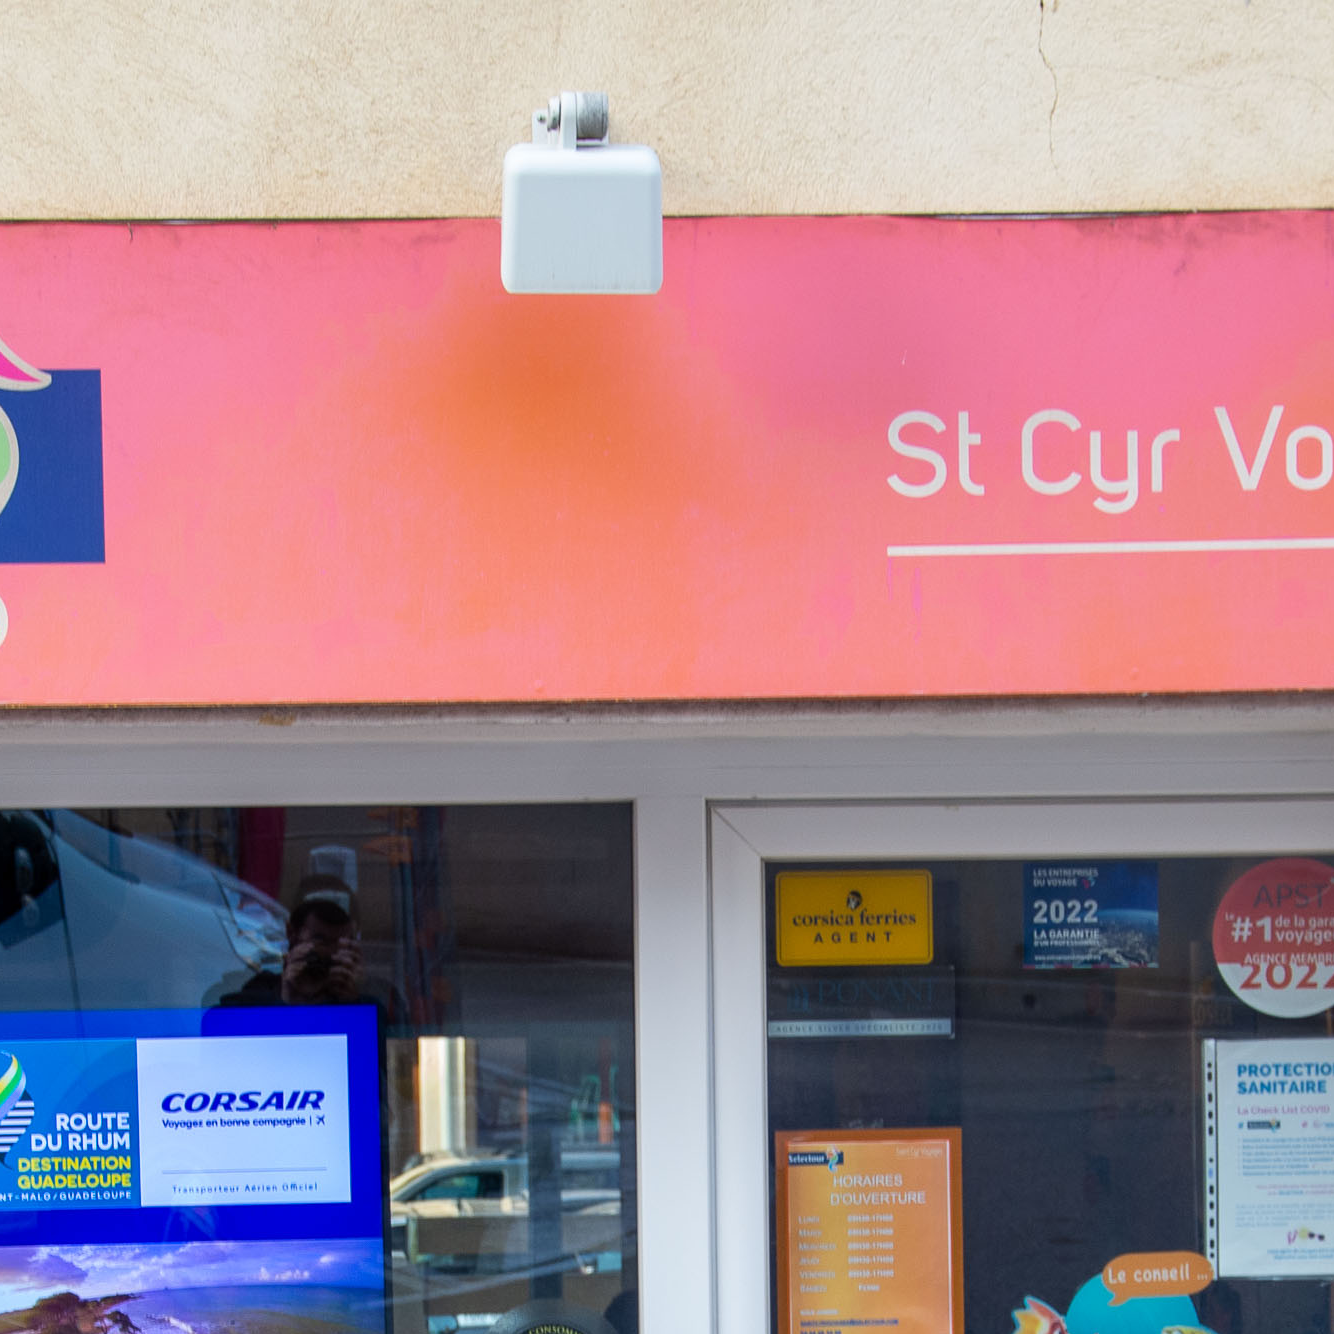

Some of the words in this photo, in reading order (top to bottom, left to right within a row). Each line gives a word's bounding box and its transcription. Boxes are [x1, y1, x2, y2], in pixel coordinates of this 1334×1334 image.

[886, 409, 985, 497] St
[1021, 408, 1181, 514] Cyr
[1047, 878, 1077, 887] VOYAGE
[1253, 884, 1327, 908] APST
[792, 909, 854, 927] corsica
[860, 908, 917, 926] ferries
[1033, 899, 1098, 924] 2022
[1034, 929, 1046, 938] LA
[1048, 928, 1099, 939] GARANTIE
[1231, 915, 1272, 943] #1
[1275, 914, 1291, 927] de
[1293, 914, 1305, 926] la
[814, 931, 893, 944] AGENT
[1244, 952, 1287, 965] AGENCE
[1237, 1080, 1328, 1095] SANITAIRE
[161, 1090, 326, 1114] CORSAIR
[1237, 1106, 1249, 1115] La
[1251, 1105, 1279, 1115] Check
[1281, 1105, 1299, 1114] List
[1300, 1104, 1331, 1114] COVID
[55, 1112, 131, 1131] ROUTE
[162, 1118, 204, 1130] Voyagez
[205, 1118, 219, 1127] en
[220, 1117, 251, 1128] bonne
[253, 1116, 306, 1130] compagnie
[31, 1133, 66, 1152] DU
[68, 1132, 131, 1151] RHUM
[17, 1156, 132, 1173] DESTINATION
[17, 1172, 132, 1190] GUADELOUPE
[172, 1183, 240, 1196] Transporteur
[244, 1182, 279, 1193] Aérien
[282, 1181, 319, 1193] Officiel
[833, 1173, 903, 1188] HORAIRES
[830, 1190, 927, 1206] D'OUVERTURE
[1108, 1267, 1126, 1284] Le
[1134, 1264, 1190, 1283] conseil
